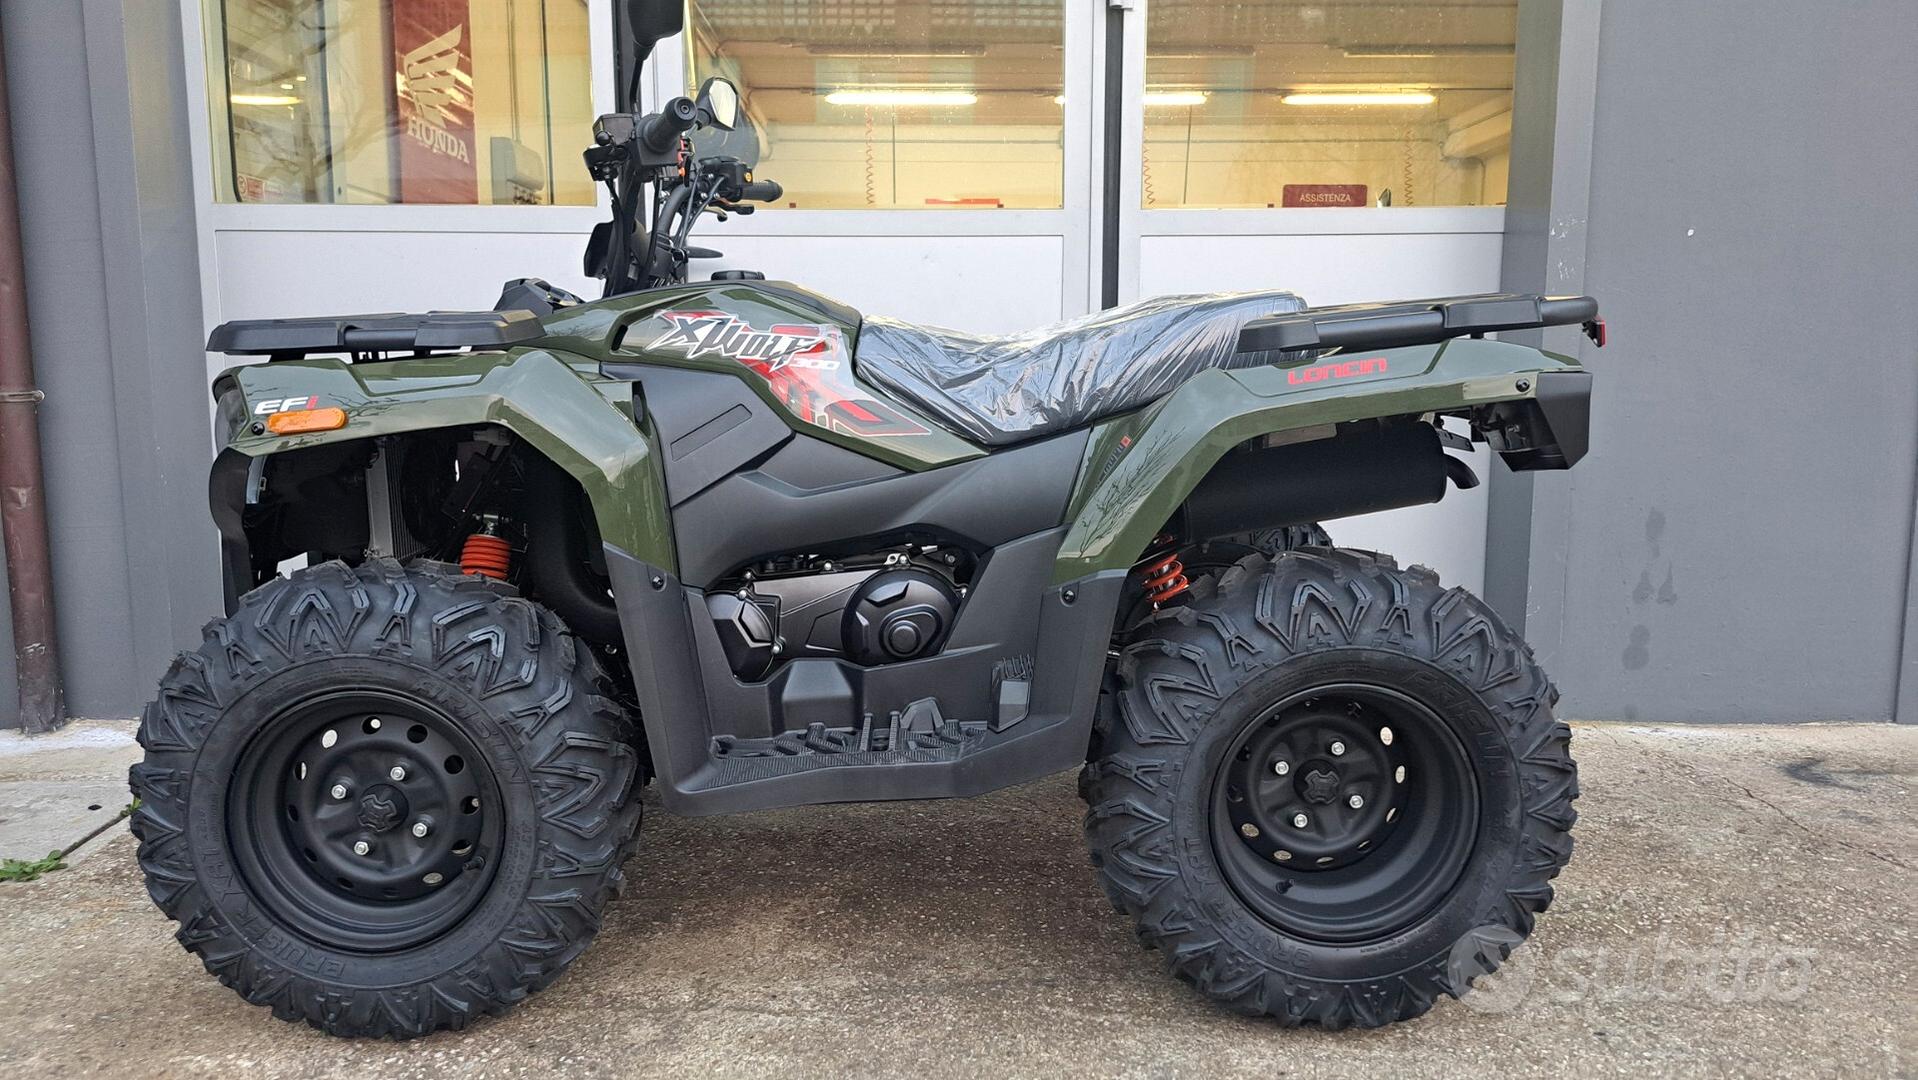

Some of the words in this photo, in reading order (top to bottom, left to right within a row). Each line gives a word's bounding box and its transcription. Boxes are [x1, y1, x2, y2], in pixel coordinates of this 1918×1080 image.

[408, 119, 470, 164] HONDA
[1300, 193, 1351, 203] ASSISTENZA
[788, 357, 840, 371] 300
[1287, 357, 1387, 386] LONCIN
